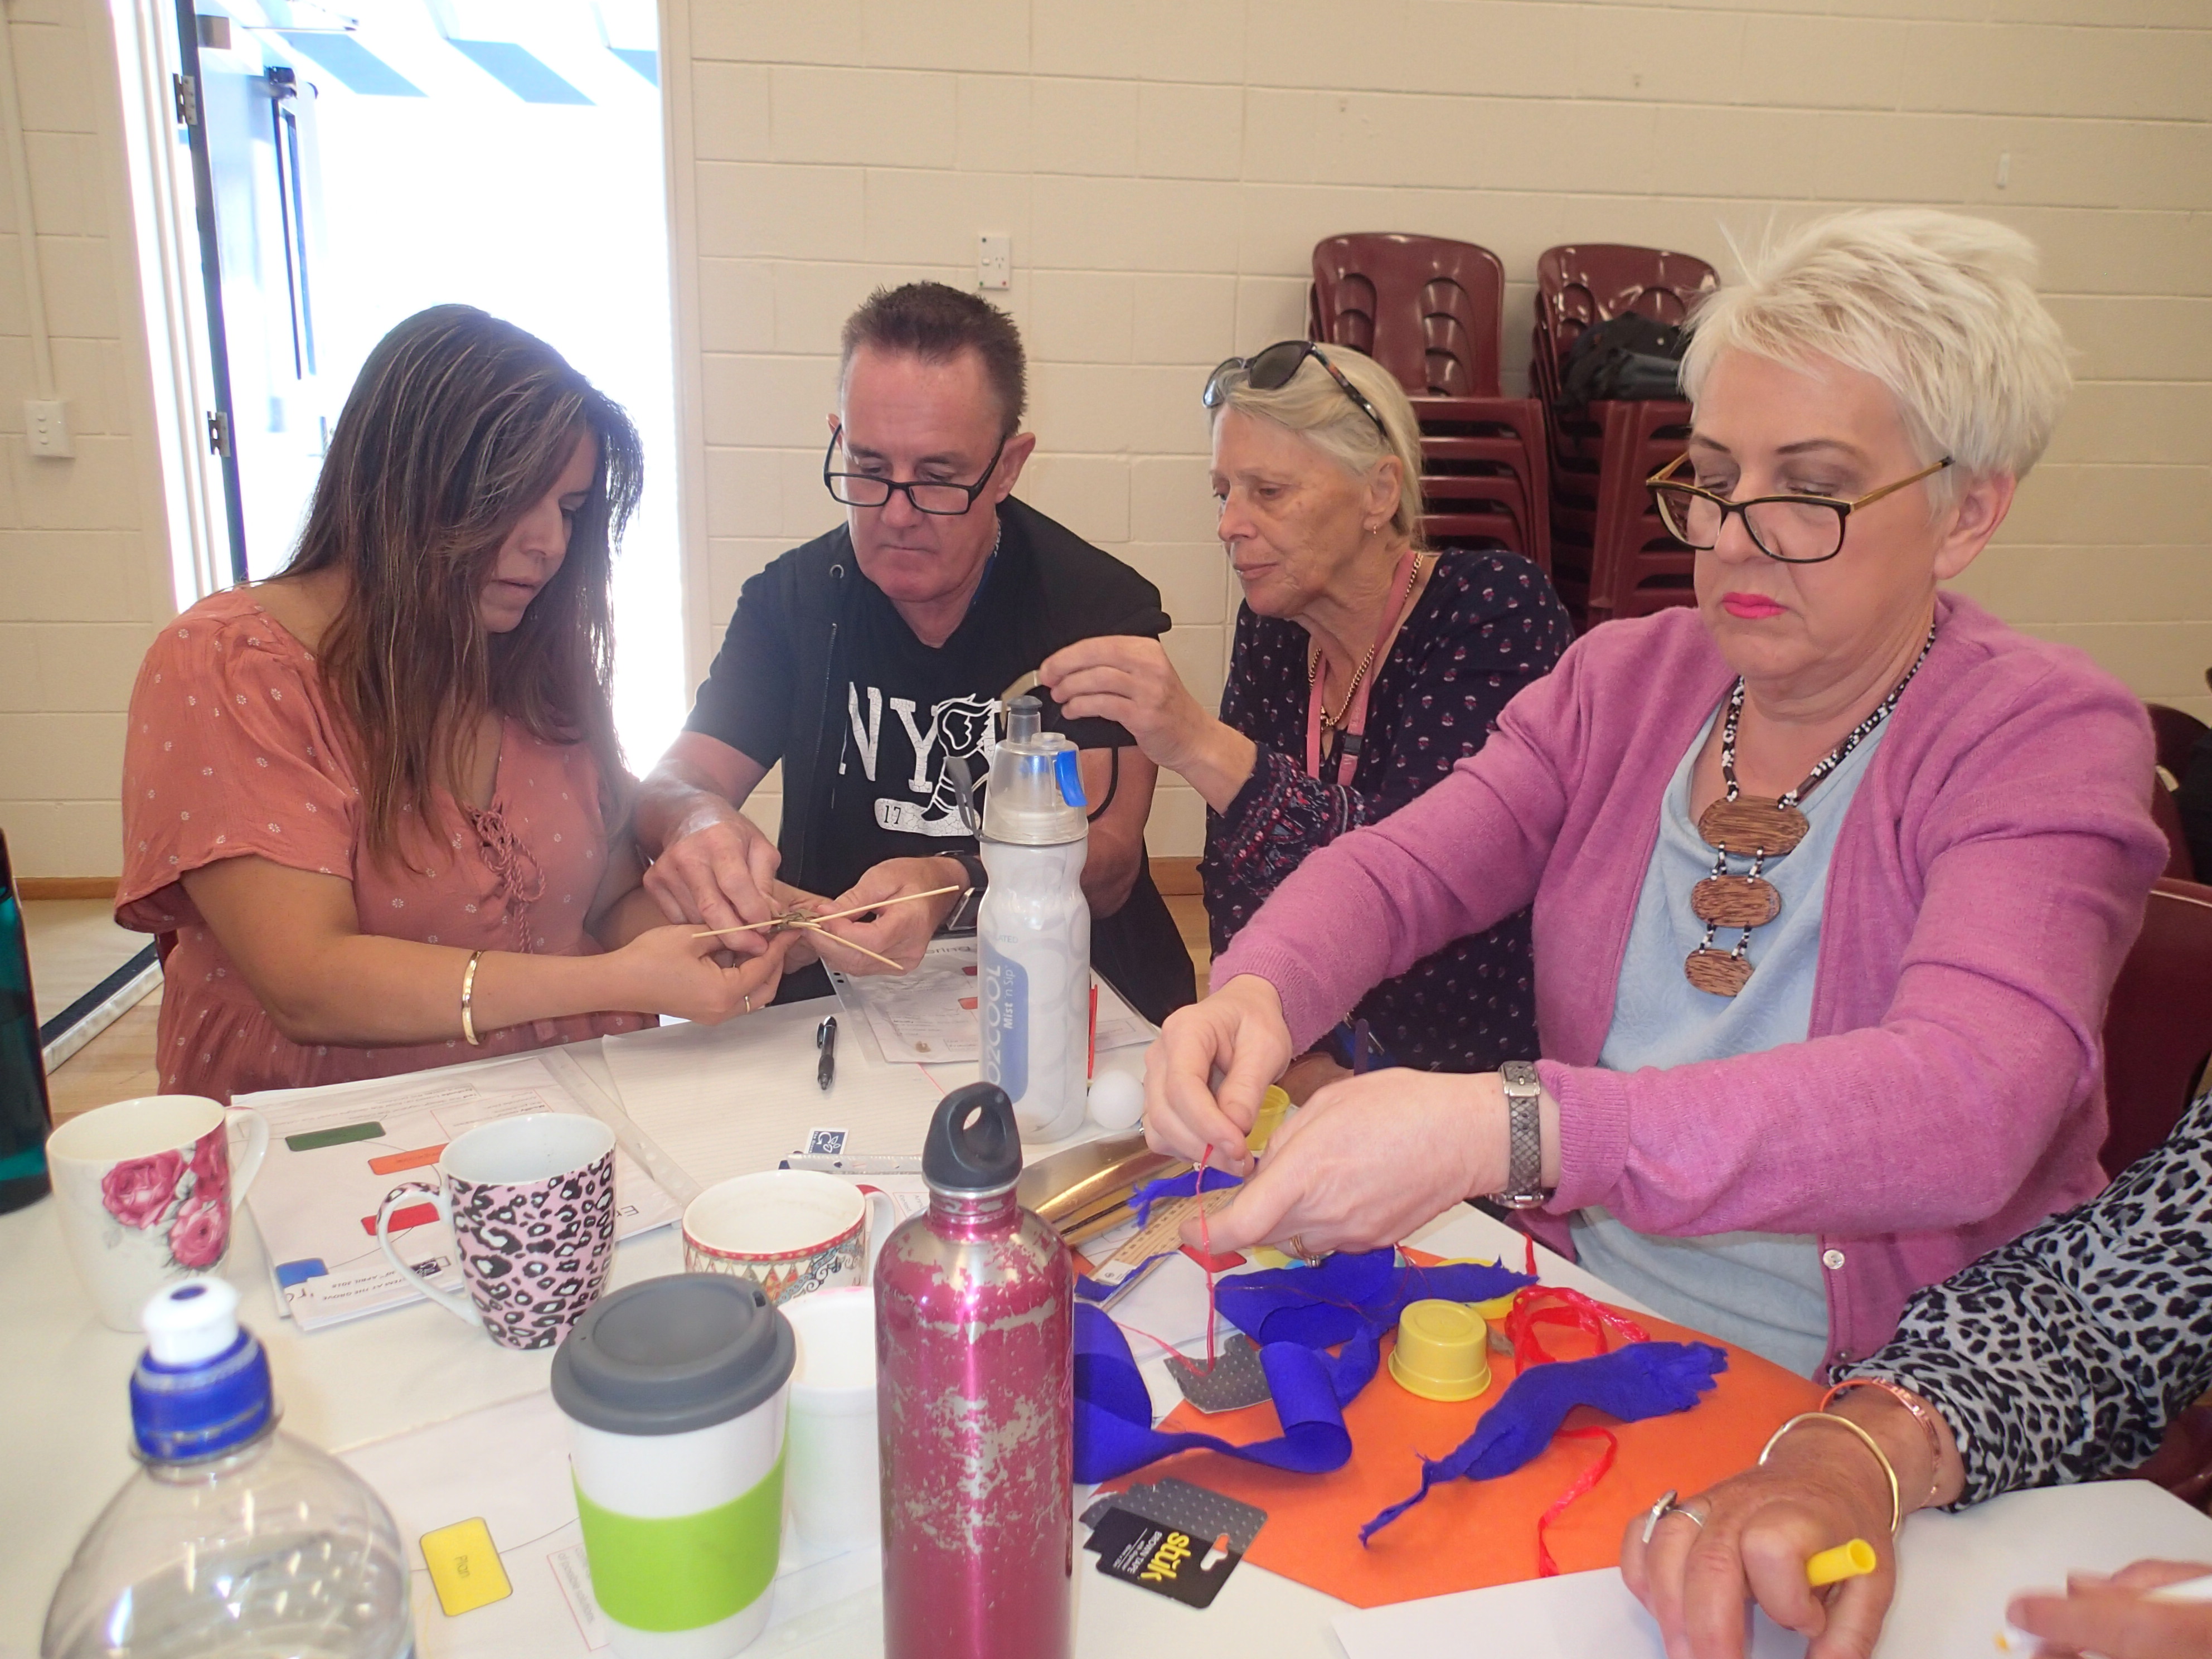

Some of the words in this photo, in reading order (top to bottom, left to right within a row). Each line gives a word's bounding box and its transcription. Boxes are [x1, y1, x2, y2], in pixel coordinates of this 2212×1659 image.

[883, 805, 901, 825] 17
[1004, 1002, 1013, 1029] Mist
[354, 1274, 378, 1283] APRIL
[322, 1291, 352, 1301] GROVE
[454, 1554, 470, 1579] Plan
[1127, 1557, 1144, 1574] TAPE
